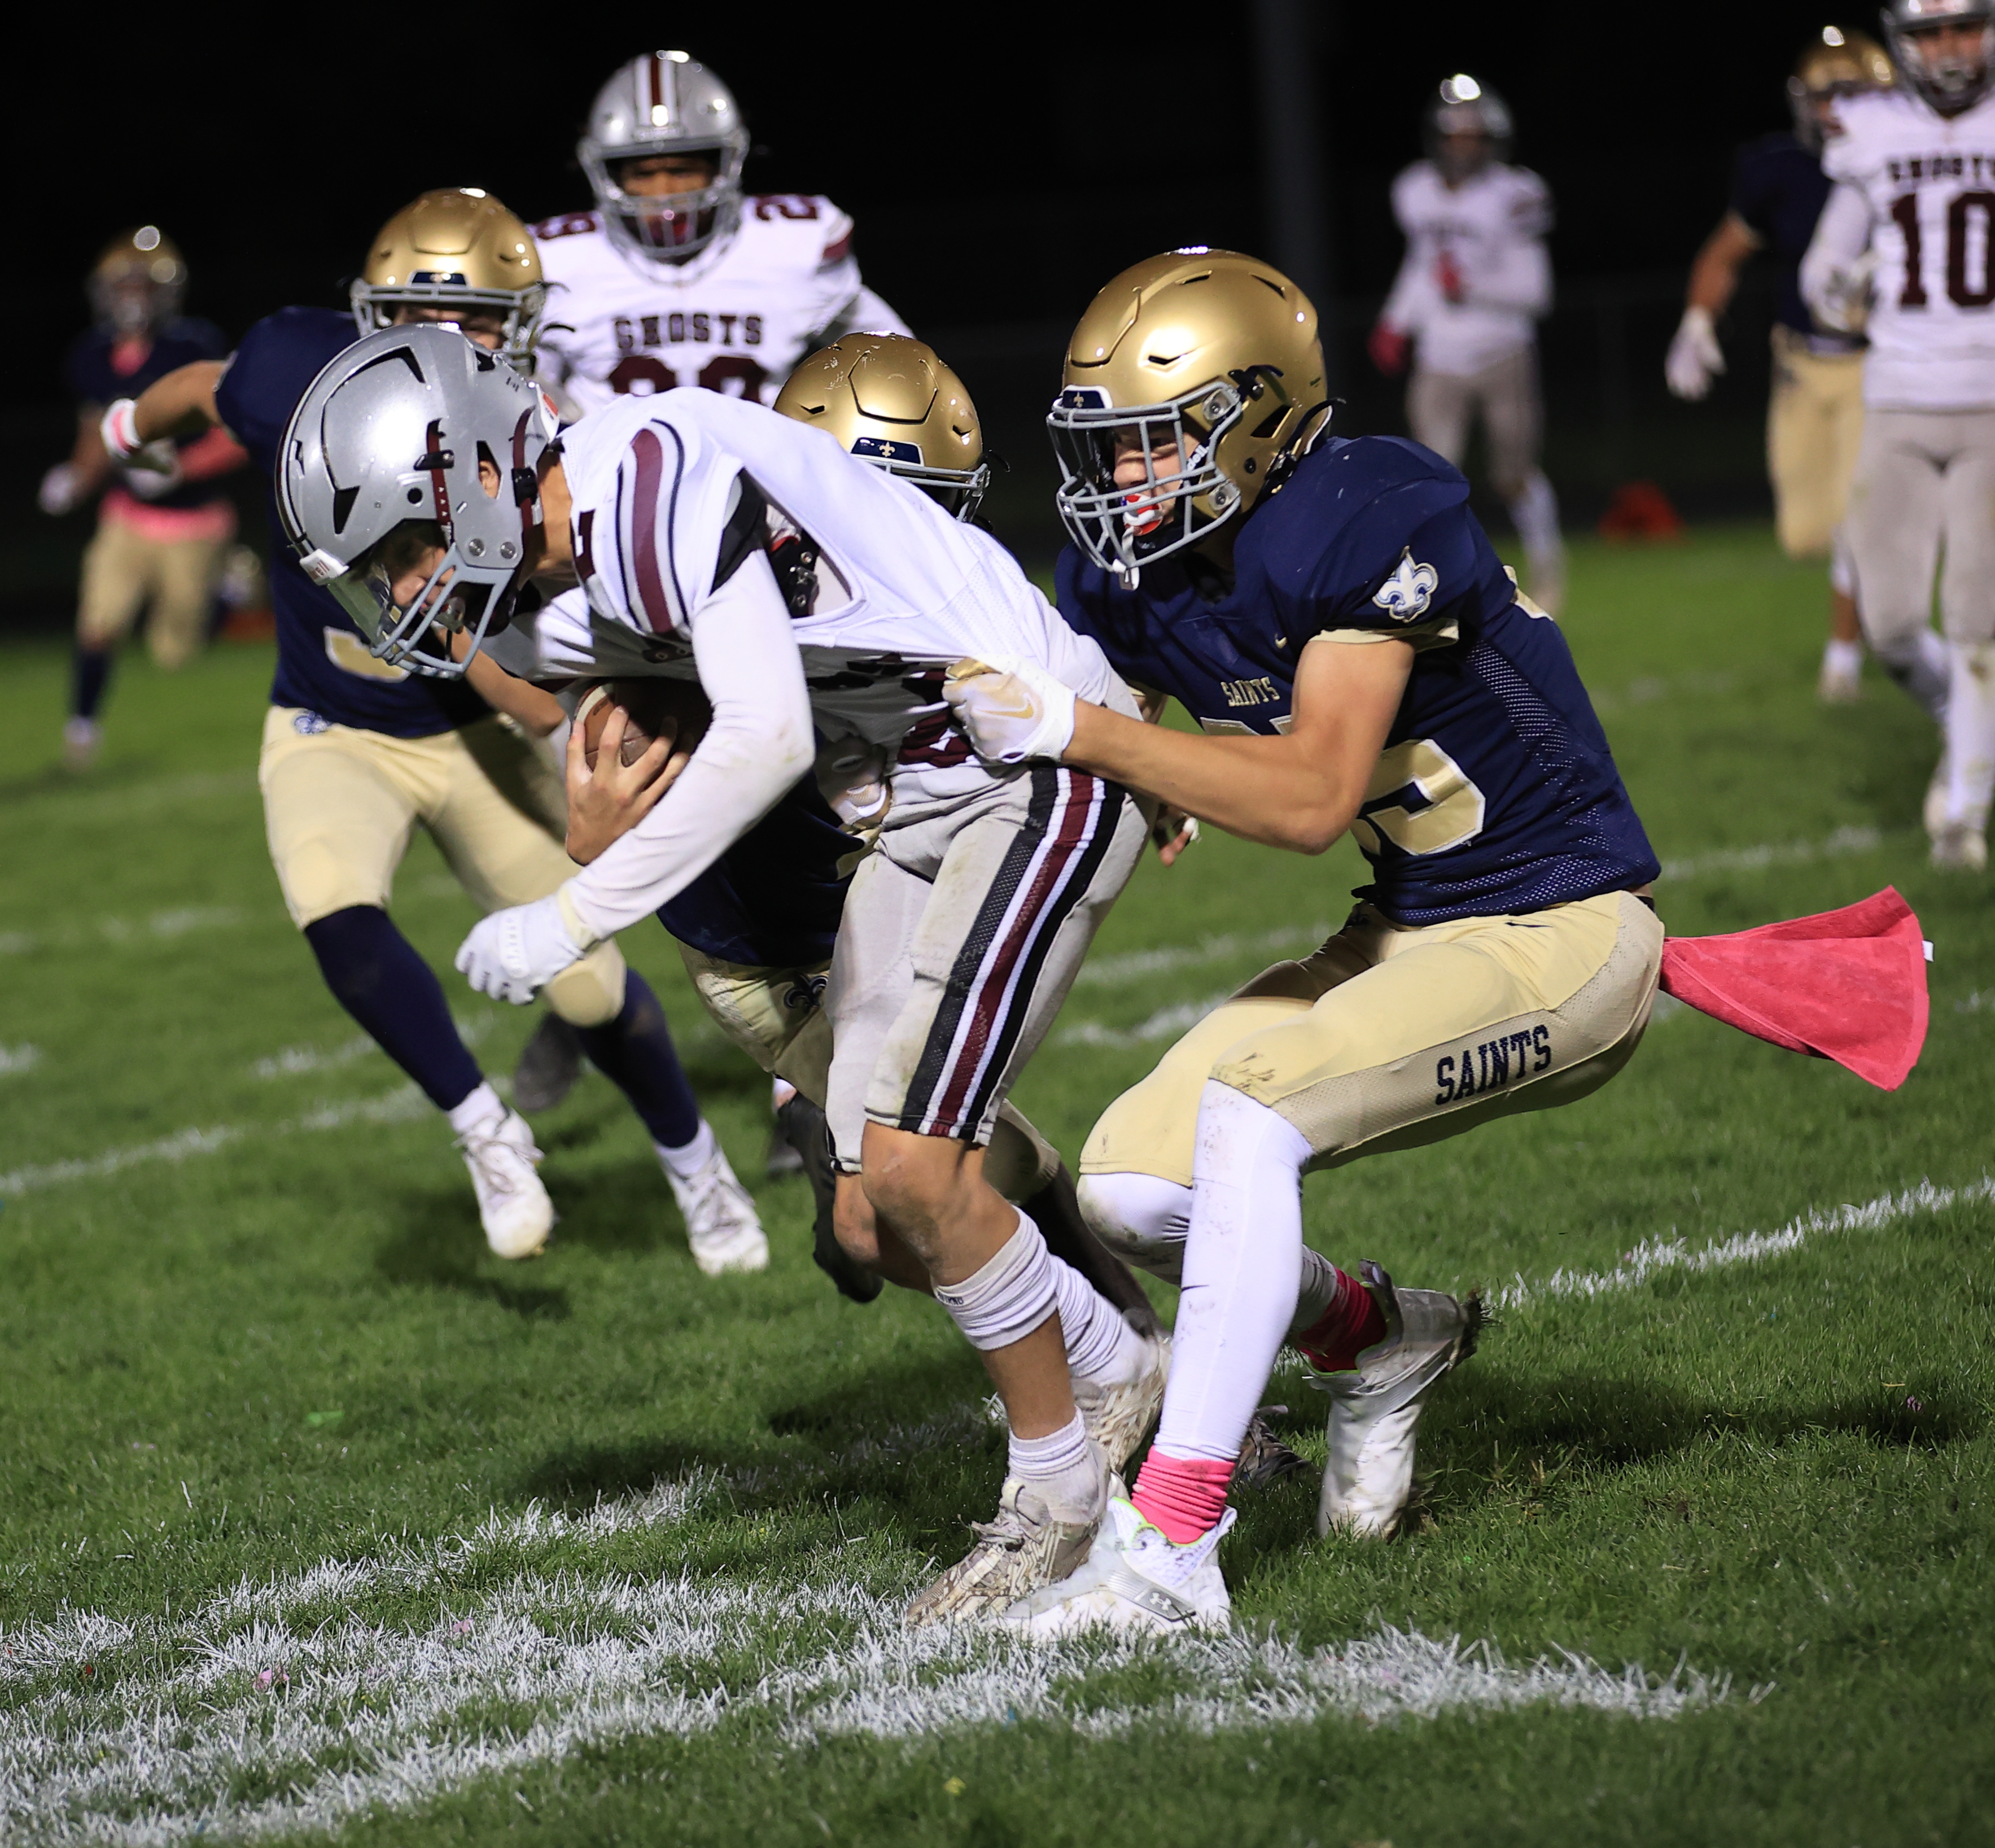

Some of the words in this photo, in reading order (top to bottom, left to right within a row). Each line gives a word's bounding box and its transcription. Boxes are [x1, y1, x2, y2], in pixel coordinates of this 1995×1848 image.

[1892, 192, 1995, 307] 10
[614, 313, 762, 349] GHOSTS
[1220, 676, 1280, 707] SAINTS
[1436, 1024, 1551, 1105] SAINTS
